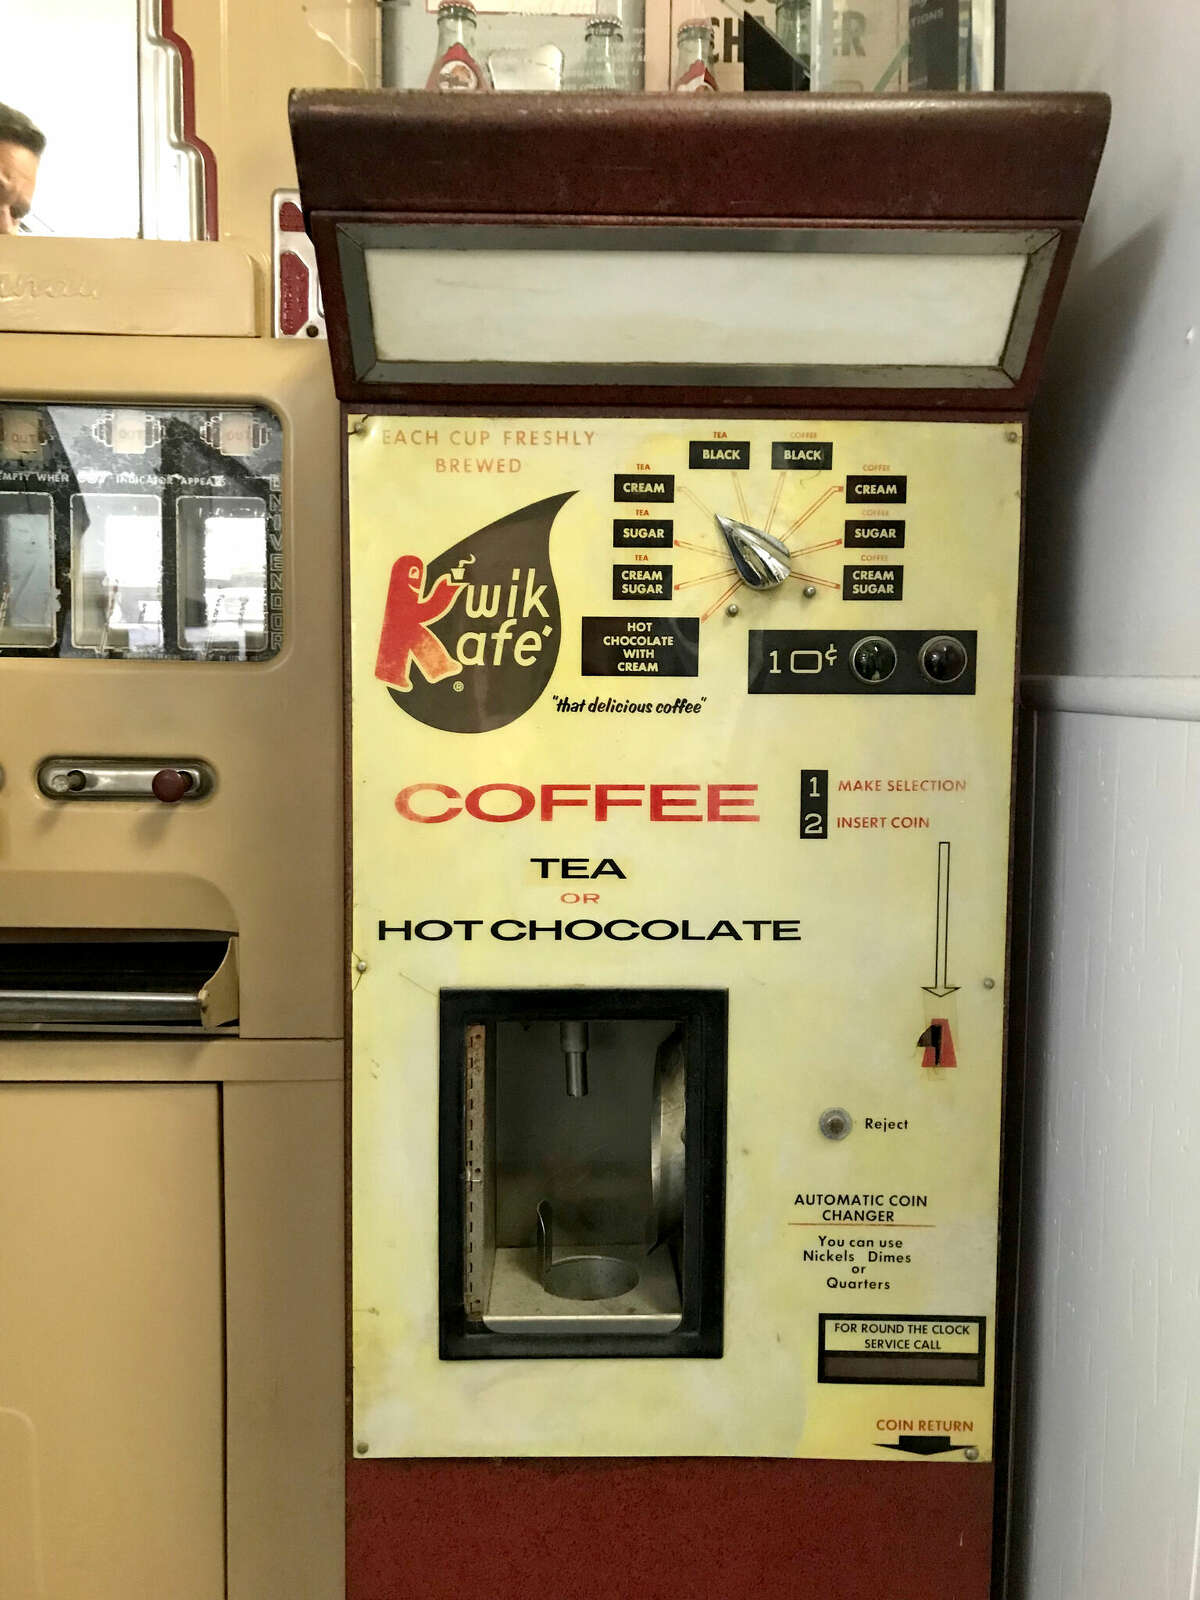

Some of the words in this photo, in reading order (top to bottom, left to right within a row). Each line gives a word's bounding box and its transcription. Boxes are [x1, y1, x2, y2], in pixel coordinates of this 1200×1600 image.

[382, 430, 439, 445] EACH
[450, 430, 490, 445] CUP
[503, 430, 596, 446] FRESHLY
[790, 431, 817, 439] COFFEE
[702, 448, 740, 461] BLACK
[783, 448, 822, 461] BLACK
[435, 458, 521, 473] BREWED
[862, 464, 891, 472] COFFEE
[622, 482, 665, 493] CREAM
[854, 483, 897, 495] CREAM
[861, 509, 890, 517] COFFEE
[622, 527, 665, 539] SUGAR
[854, 527, 896, 539] SUGAR
[860, 554, 889, 562] COFFEE
[621, 570, 663, 581] CREAM
[852, 570, 895, 581] CREAM
[621, 584, 663, 595] SUGAR
[852, 583, 894, 595] SUGAR
[627, 622, 652, 632] HOT
[603, 635, 674, 646] CHOCOLATE
[623, 648, 655, 659] WITH
[617, 662, 659, 673] CREAM
[587, 696, 652, 713] delicious
[808, 776, 821, 798] 1
[838, 779, 882, 792] MAKE
[887, 779, 967, 792] SELECTION
[394, 783, 760, 824] COFFEE
[804, 813, 823, 834] 2
[836, 816, 887, 829] INSERT
[891, 816, 930, 829] COIN
[530, 858, 627, 879] TEA
[560, 893, 600, 904] OR
[378, 920, 483, 941] HOT
[490, 919, 801, 942] CHOCOLATE
[865, 1117, 909, 1131] Reject
[794, 1194, 884, 1206] AUTOMATIC
[888, 1195, 928, 1207] COIN
[822, 1210, 895, 1222] CHANGER
[818, 1235, 845, 1248] You
[849, 1239, 874, 1248] can
[879, 1239, 903, 1249] use
[803, 1250, 855, 1263] Nickels
[867, 1250, 912, 1264] Dimes
[851, 1265, 866, 1274] or
[826, 1277, 890, 1291] Quarters
[834, 1322, 857, 1333] FOR
[861, 1323, 905, 1334] ROUND
[908, 1324, 928, 1335] THE
[932, 1325, 970, 1336] CLOCK
[864, 1339, 910, 1350] SERVICE
[914, 1339, 941, 1350] CALL
[876, 1419, 914, 1431] COIN
[918, 1420, 974, 1432] RETURN
